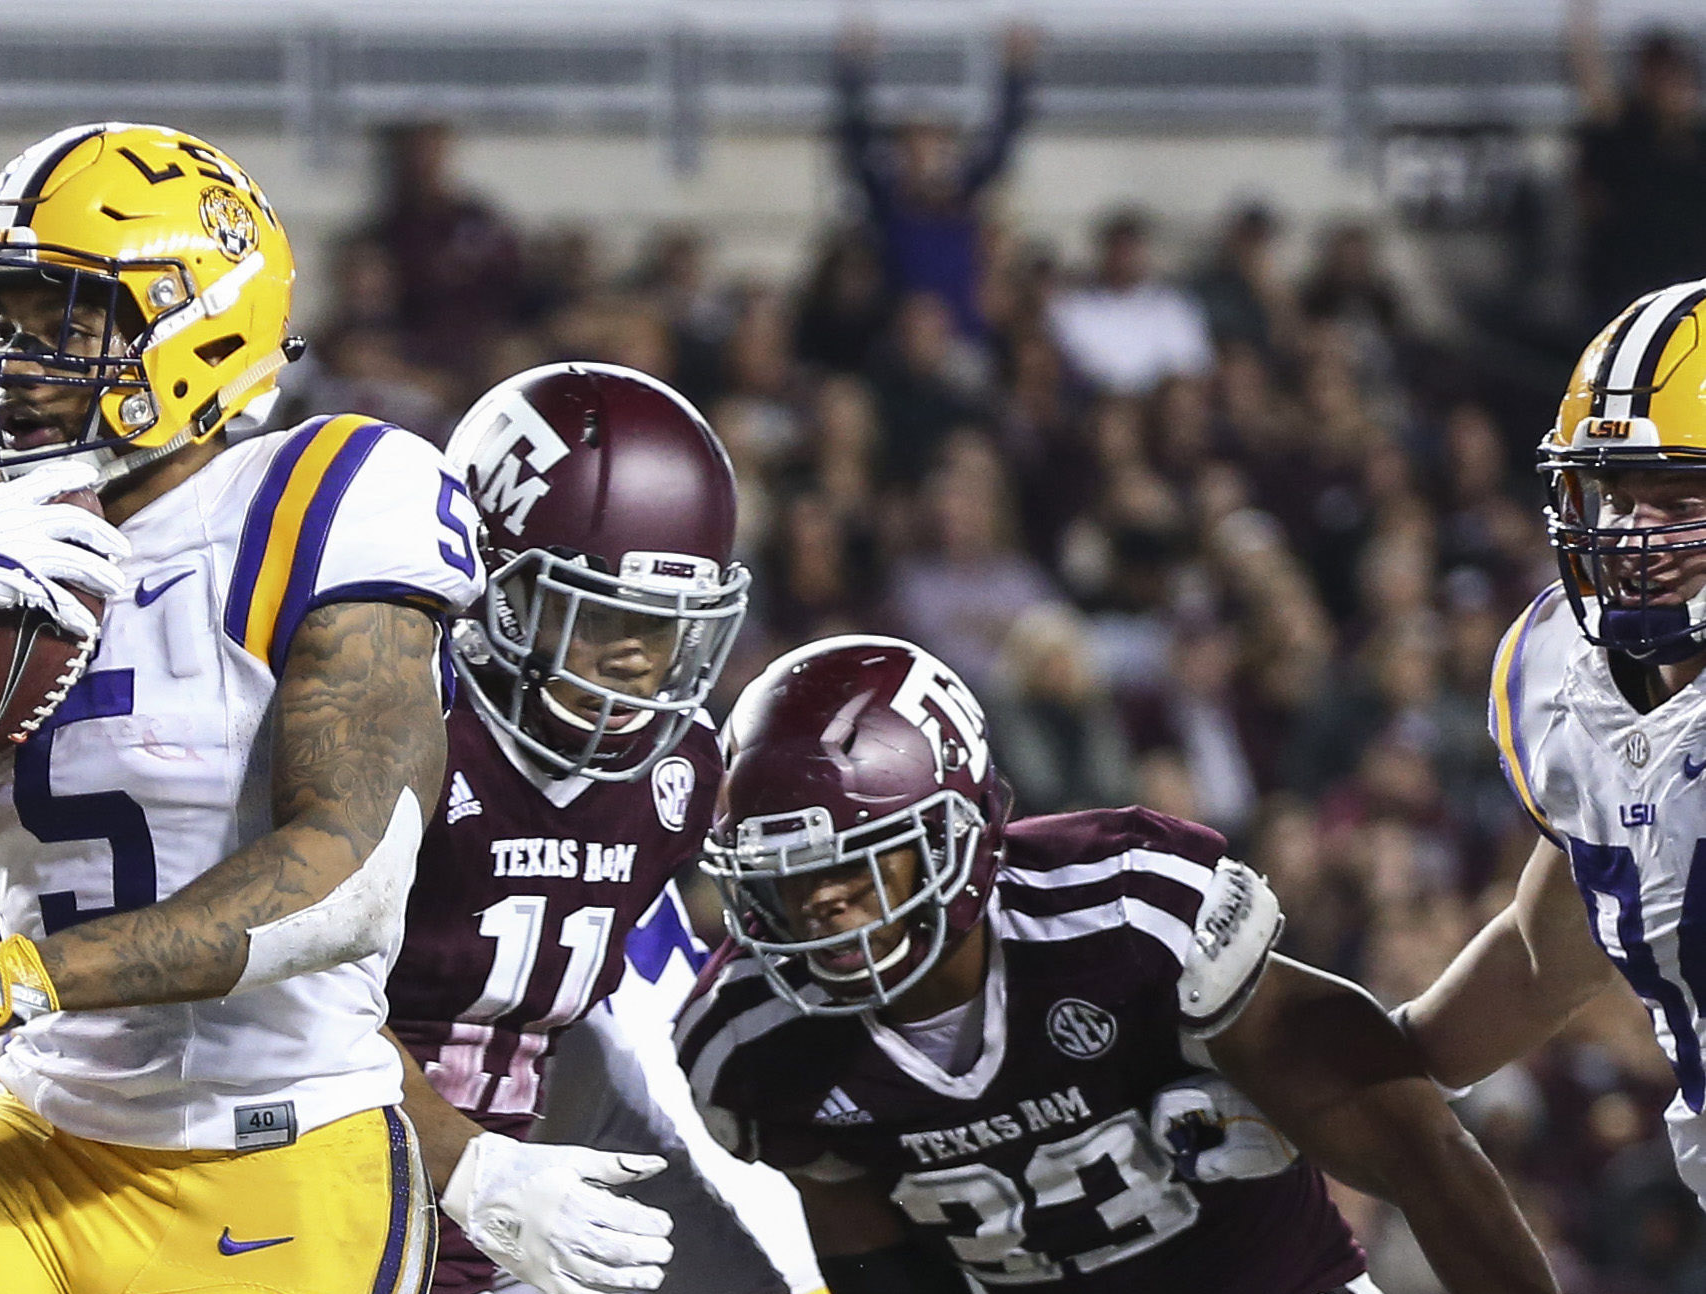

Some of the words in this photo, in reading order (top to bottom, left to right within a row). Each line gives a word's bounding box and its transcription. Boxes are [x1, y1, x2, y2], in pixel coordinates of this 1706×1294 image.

[1586, 420, 1631, 439] LSU
[436, 467, 476, 581] 5
[12, 666, 157, 938] 5
[1619, 803, 1656, 828] LSU
[490, 837, 579, 879] TEXAS
[582, 842, 638, 883] A&M
[424, 894, 627, 1117] 11
[1051, 1001, 1113, 1056] SEC
[250, 1111, 274, 1128] 40
[899, 1114, 1022, 1164] TEXAS
[1018, 1086, 1092, 1132] A&M
